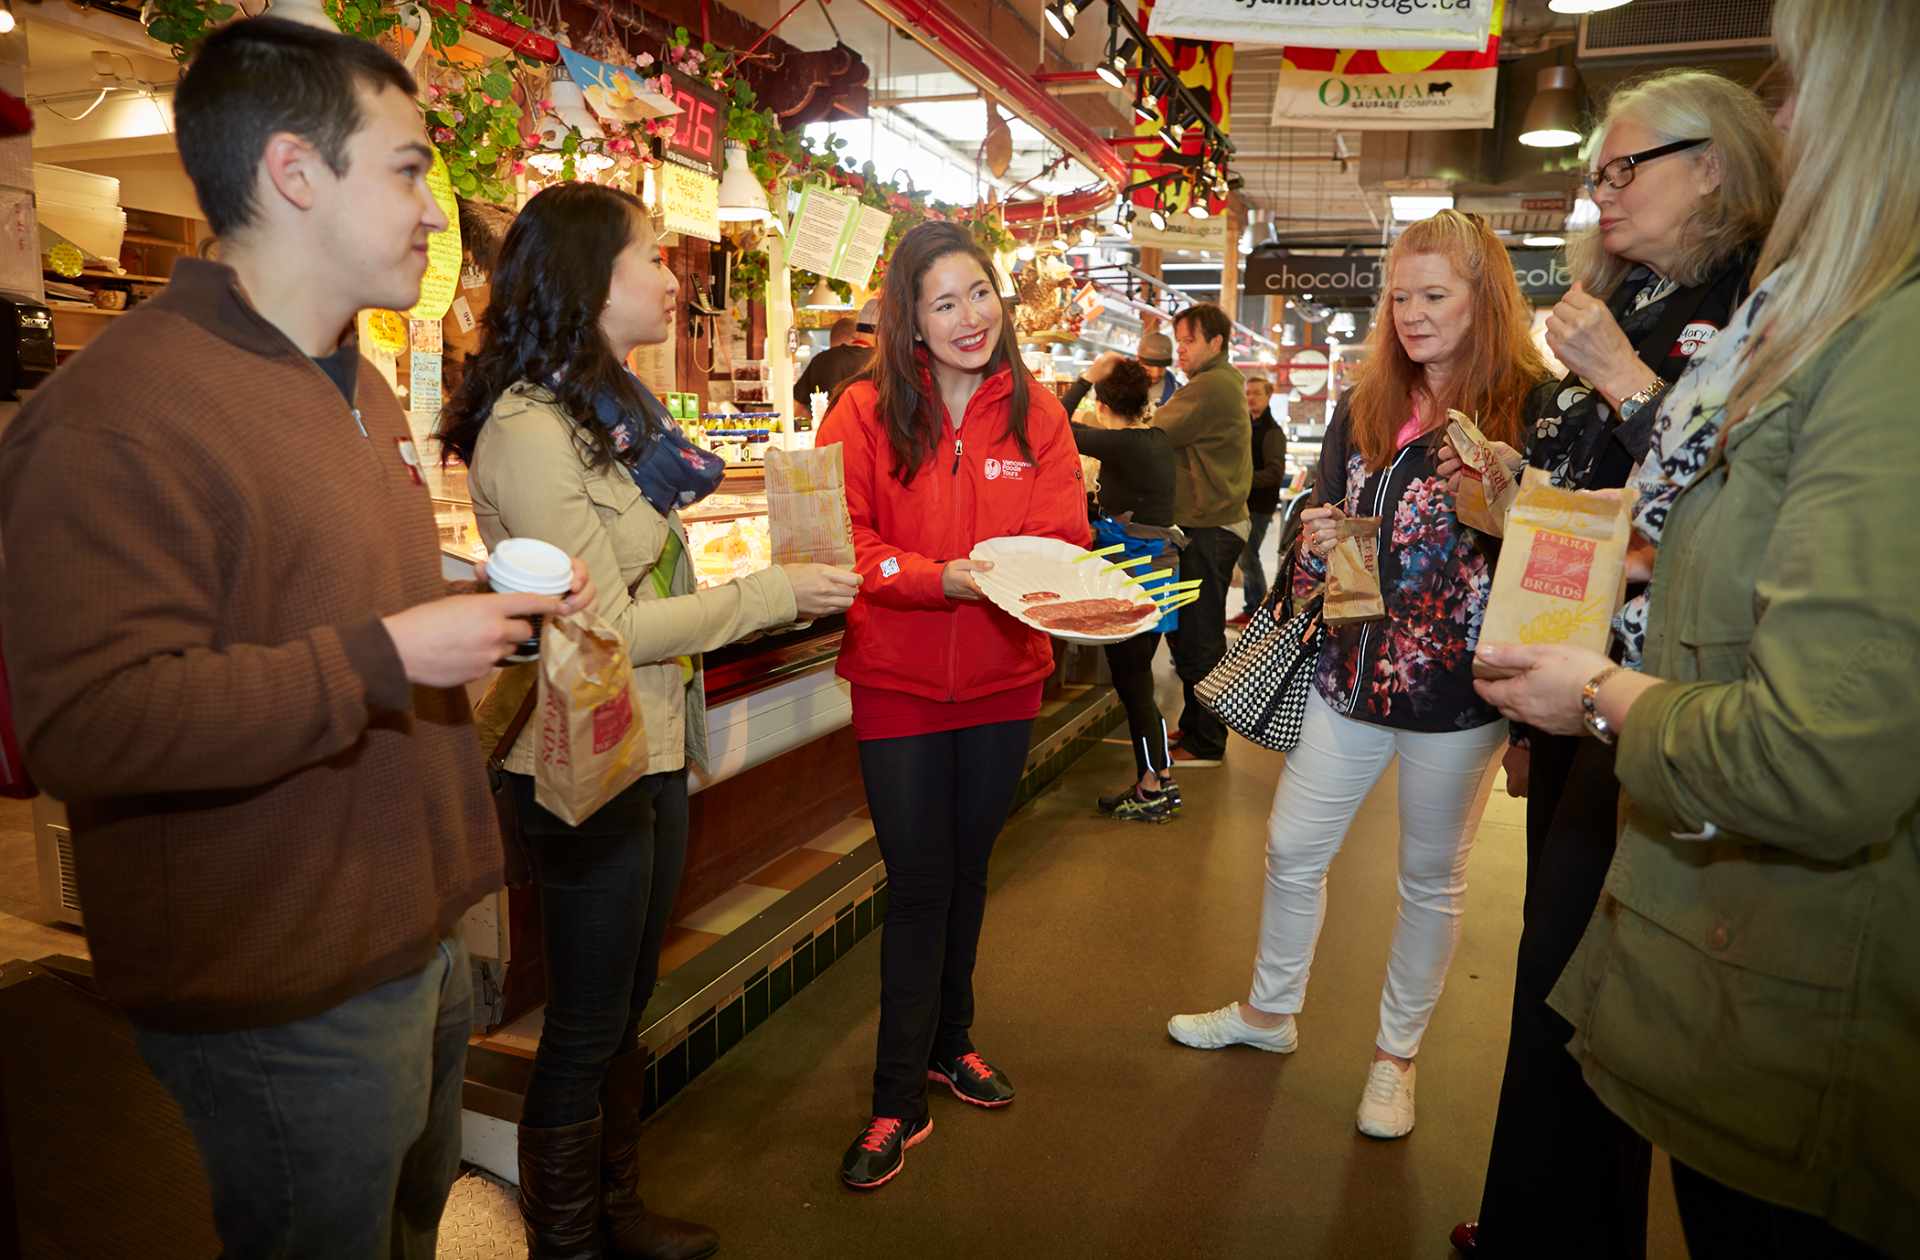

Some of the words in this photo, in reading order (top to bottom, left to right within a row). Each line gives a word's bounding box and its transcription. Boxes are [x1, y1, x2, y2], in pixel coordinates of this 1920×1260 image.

[1318, 78, 1423, 108] OYAMA
[1351, 100, 1400, 109] SAUSAGE
[1403, 99, 1451, 108] COMPANY
[1541, 531, 1591, 551] TERRA
[1523, 577, 1583, 600] BREADS
